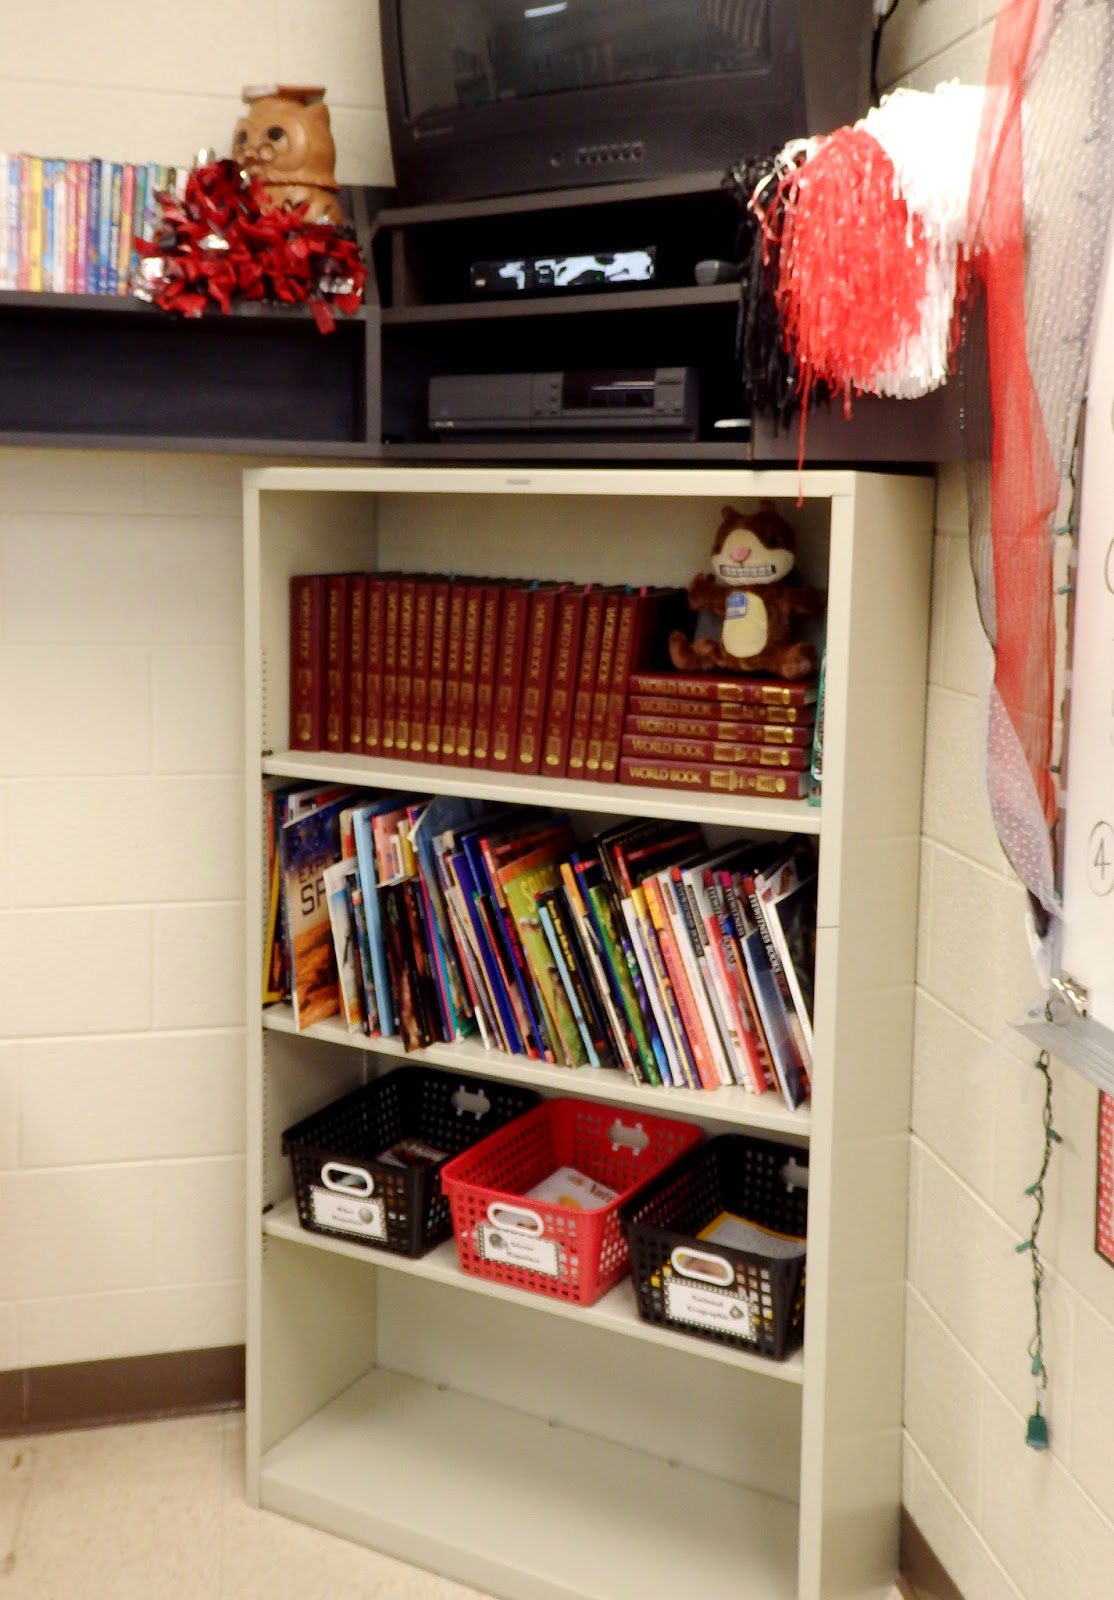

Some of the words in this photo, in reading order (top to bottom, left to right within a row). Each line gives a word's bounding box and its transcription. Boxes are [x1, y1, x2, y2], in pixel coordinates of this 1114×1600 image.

[603, 608, 615, 648] WORLD
[599, 650, 610, 684] BOOK
[639, 700, 677, 712] WORLD
[680, 702, 711, 715] BOOK
[636, 720, 675, 732] WORLD
[678, 723, 707, 735] BOOK
[632, 739, 670, 753] WORLD
[674, 744, 704, 757] BOOK
[629, 767, 668, 780] WORLD
[670, 770, 702, 784] BOOK
[1094, 838, 1111, 880] 4
[748, 893, 772, 944] EYEWITNESS
[765, 943, 782, 974] BOOKS
